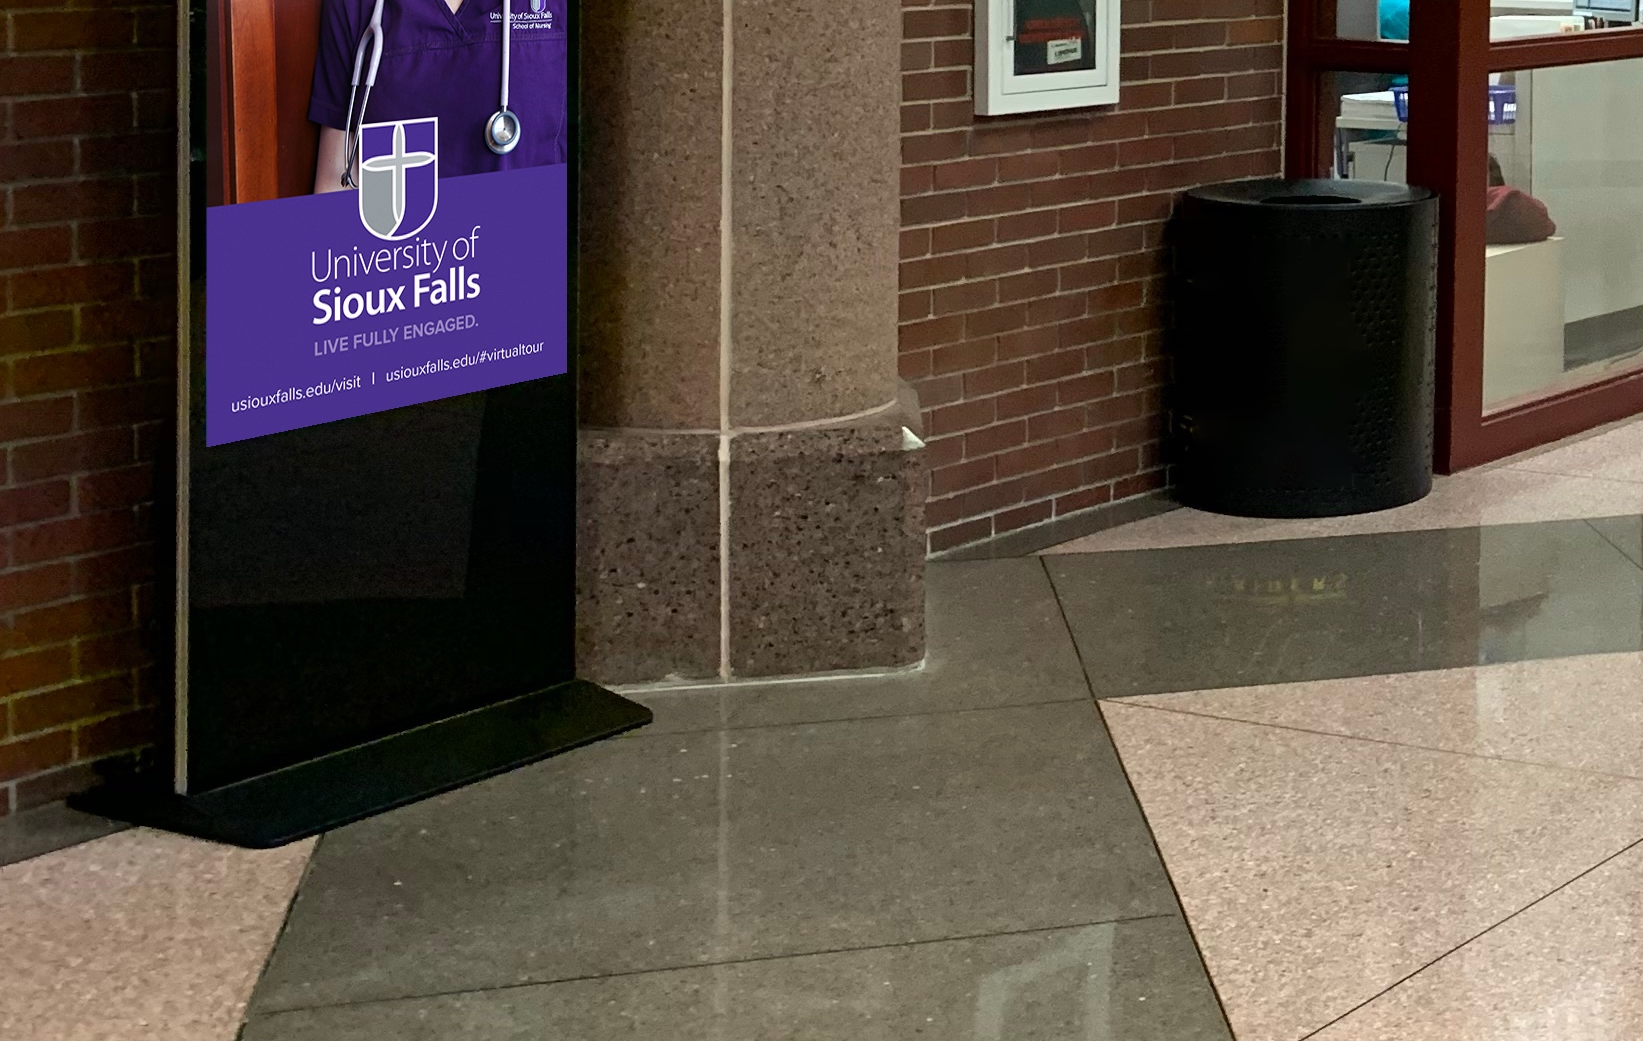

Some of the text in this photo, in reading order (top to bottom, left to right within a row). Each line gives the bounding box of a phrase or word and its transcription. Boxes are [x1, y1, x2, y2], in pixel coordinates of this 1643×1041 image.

[489, 12, 517, 21] Univity
[540, 11, 553, 19] Falls
[312, 225, 481, 283] University of
[312, 265, 481, 325] Sioux Falls
[314, 314, 479, 356] LIVE FULLY ENGAGED.
[230, 375, 362, 413] usiouxfalls.edu/visit
[385, 341, 545, 383] usiouxfalls.edu/#virtualtour
